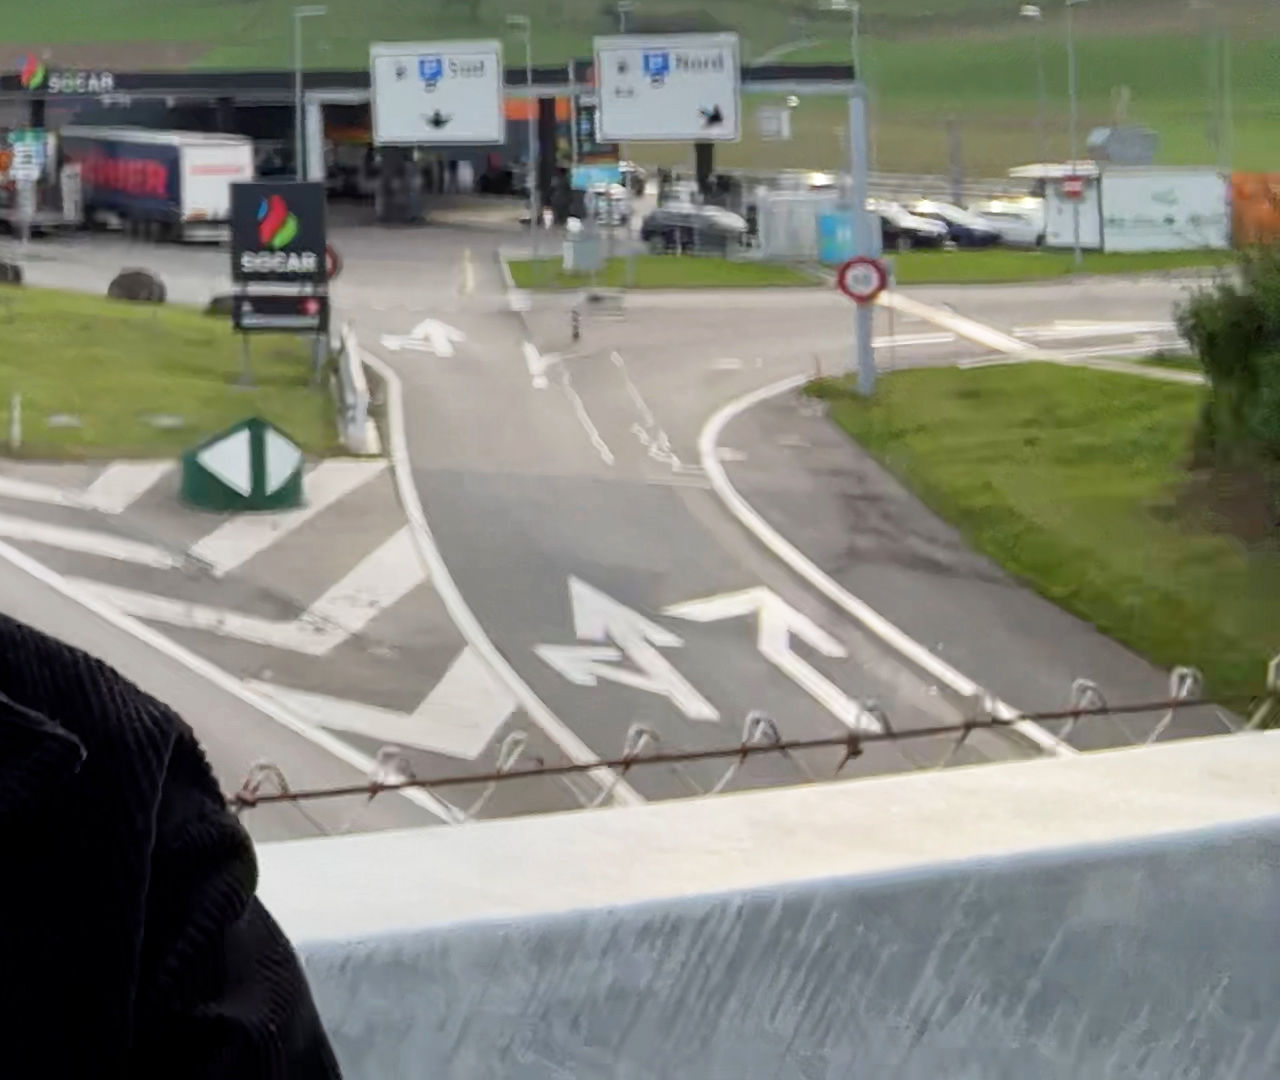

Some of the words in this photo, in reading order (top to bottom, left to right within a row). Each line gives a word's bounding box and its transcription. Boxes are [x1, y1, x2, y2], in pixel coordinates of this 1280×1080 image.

[675, 52, 724, 72] Nord
[48, 71, 115, 94] SOCAR
[240, 251, 318, 273] SOCAR
